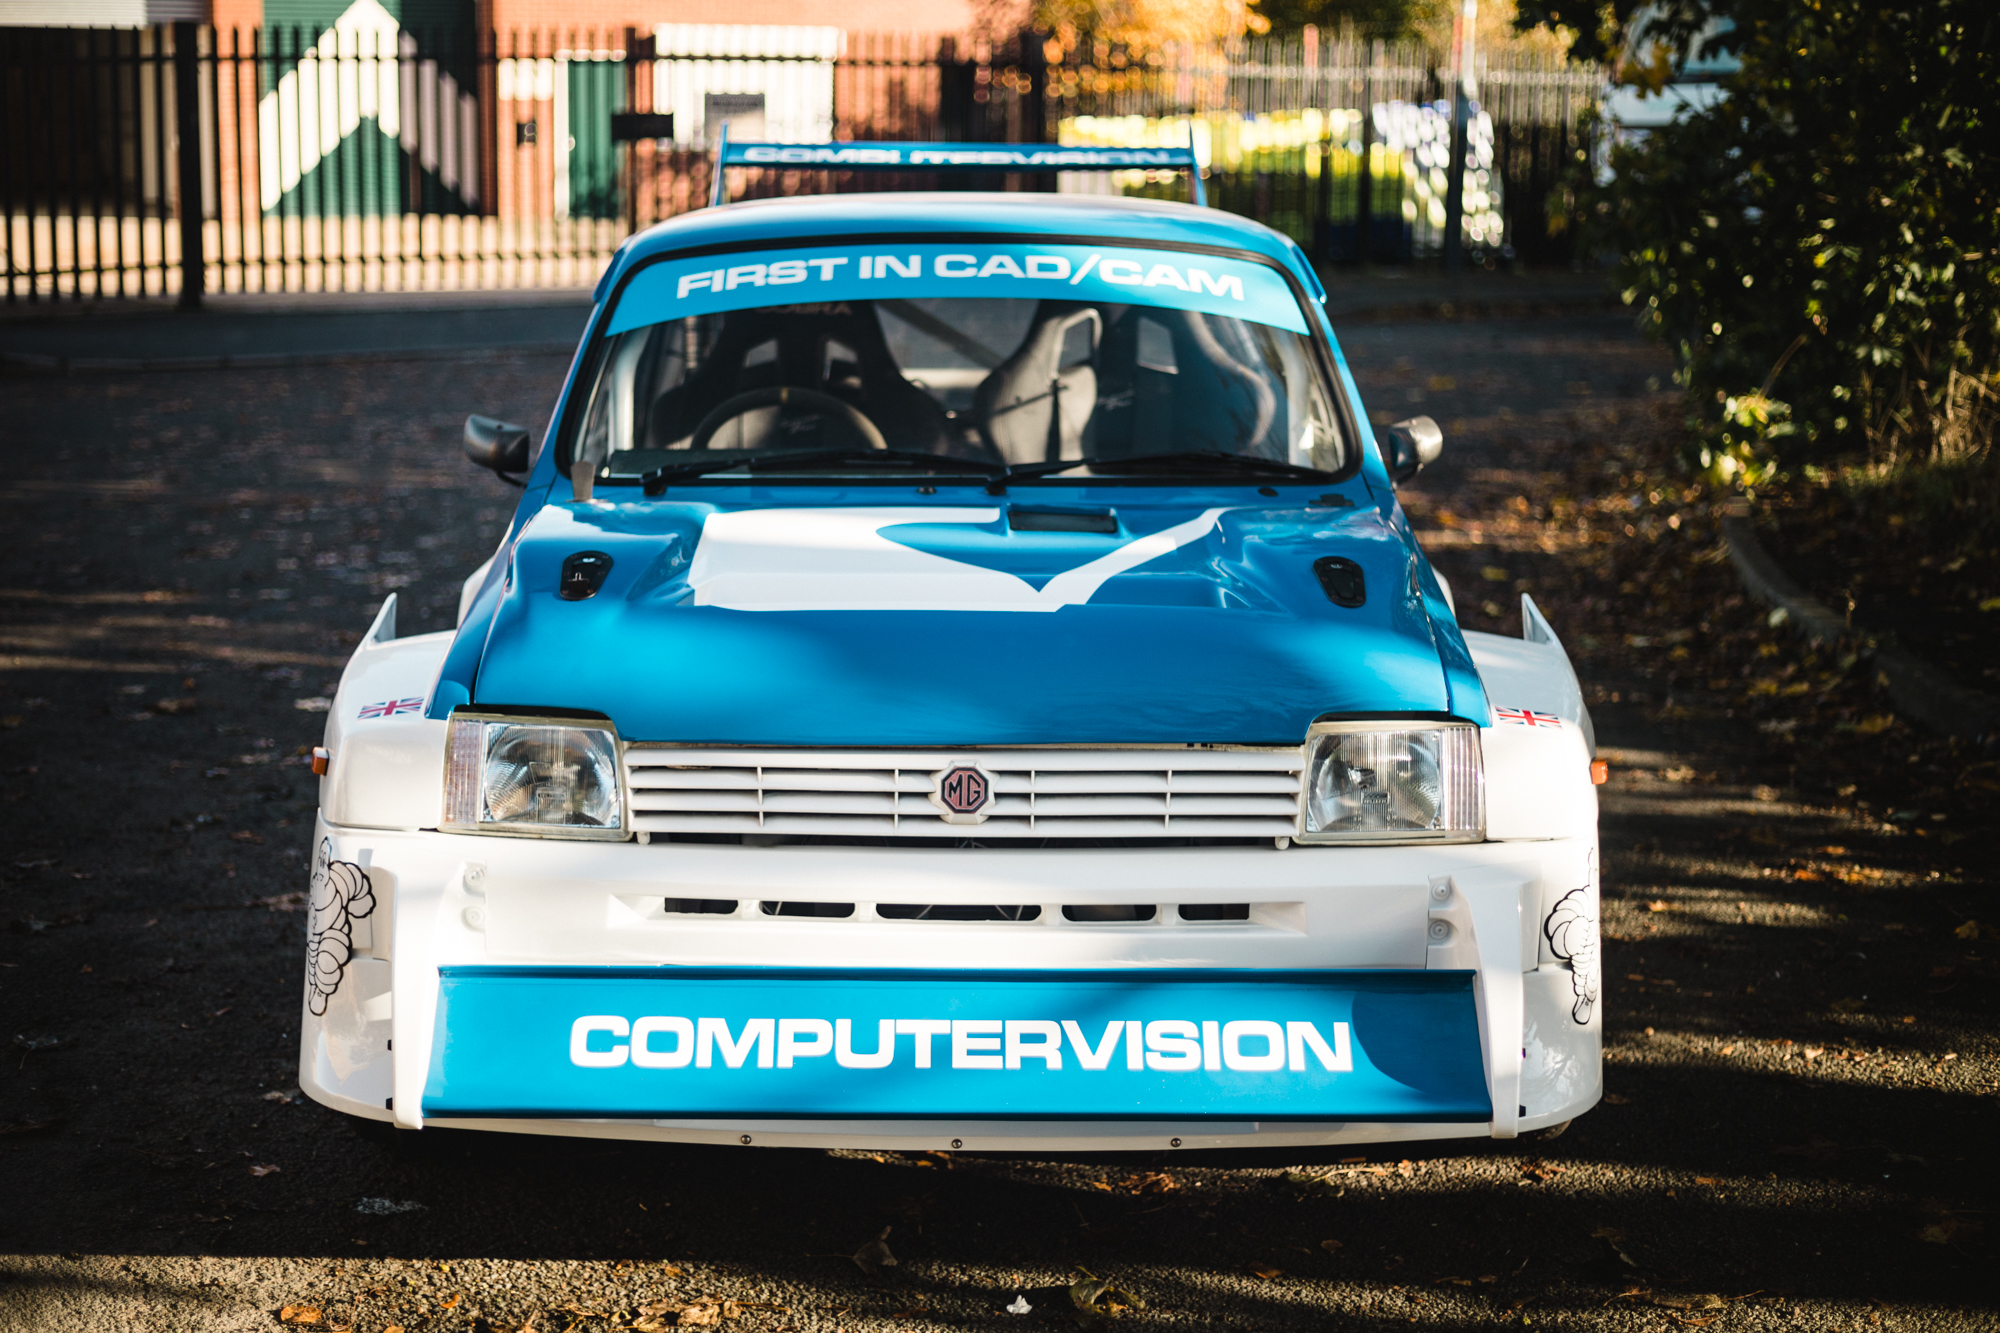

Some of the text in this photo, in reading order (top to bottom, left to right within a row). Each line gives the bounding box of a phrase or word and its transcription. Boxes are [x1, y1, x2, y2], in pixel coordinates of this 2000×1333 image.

[677, 253, 1245, 301] FIRST IN CAD/CAM
[948, 773, 982, 807] MG
[570, 1014, 1353, 1071] COMPUTERVISION
